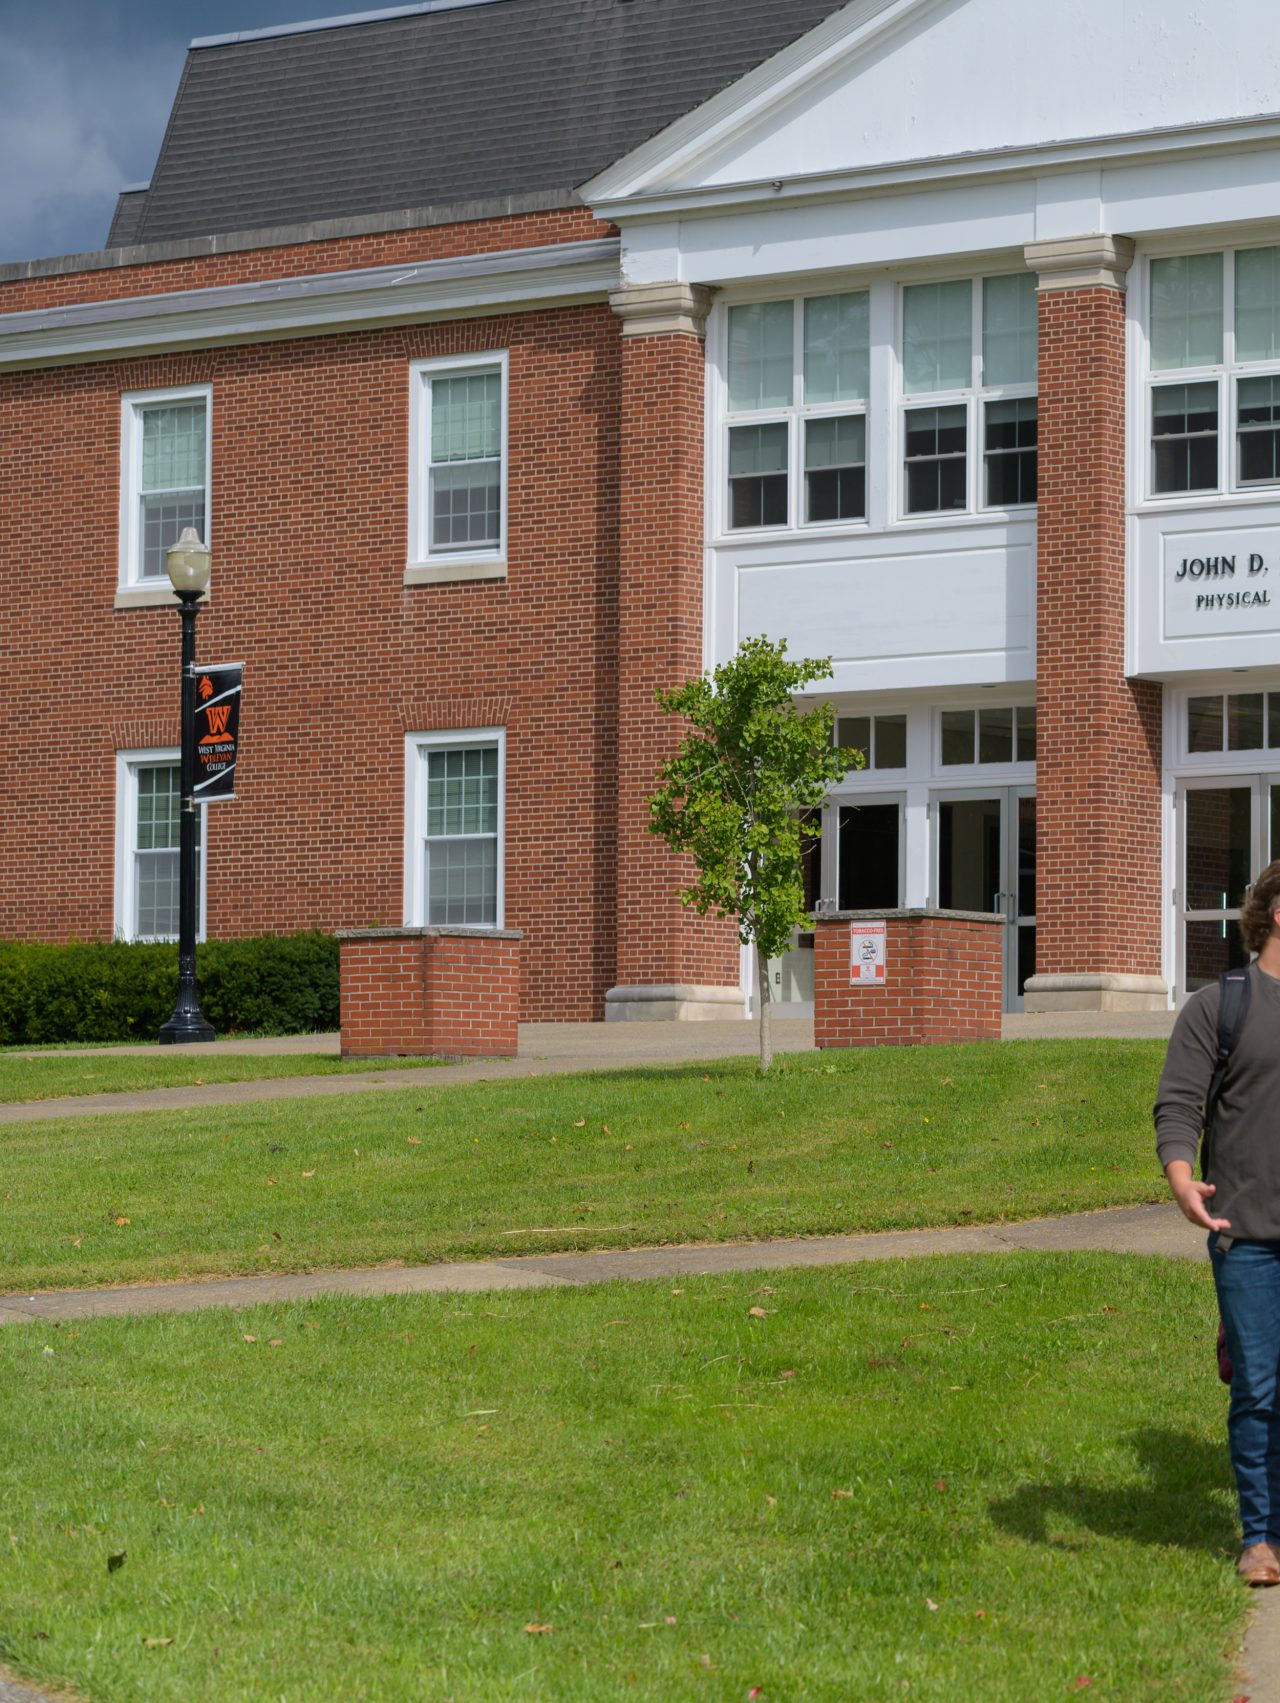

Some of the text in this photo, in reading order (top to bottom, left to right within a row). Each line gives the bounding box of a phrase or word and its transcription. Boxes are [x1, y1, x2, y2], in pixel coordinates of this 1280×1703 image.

[1176, 556, 1236, 577] JOHN
[1249, 553, 1269, 572] D.
[1197, 589, 1271, 608] PHYSICAL
[206, 706, 231, 734] W
